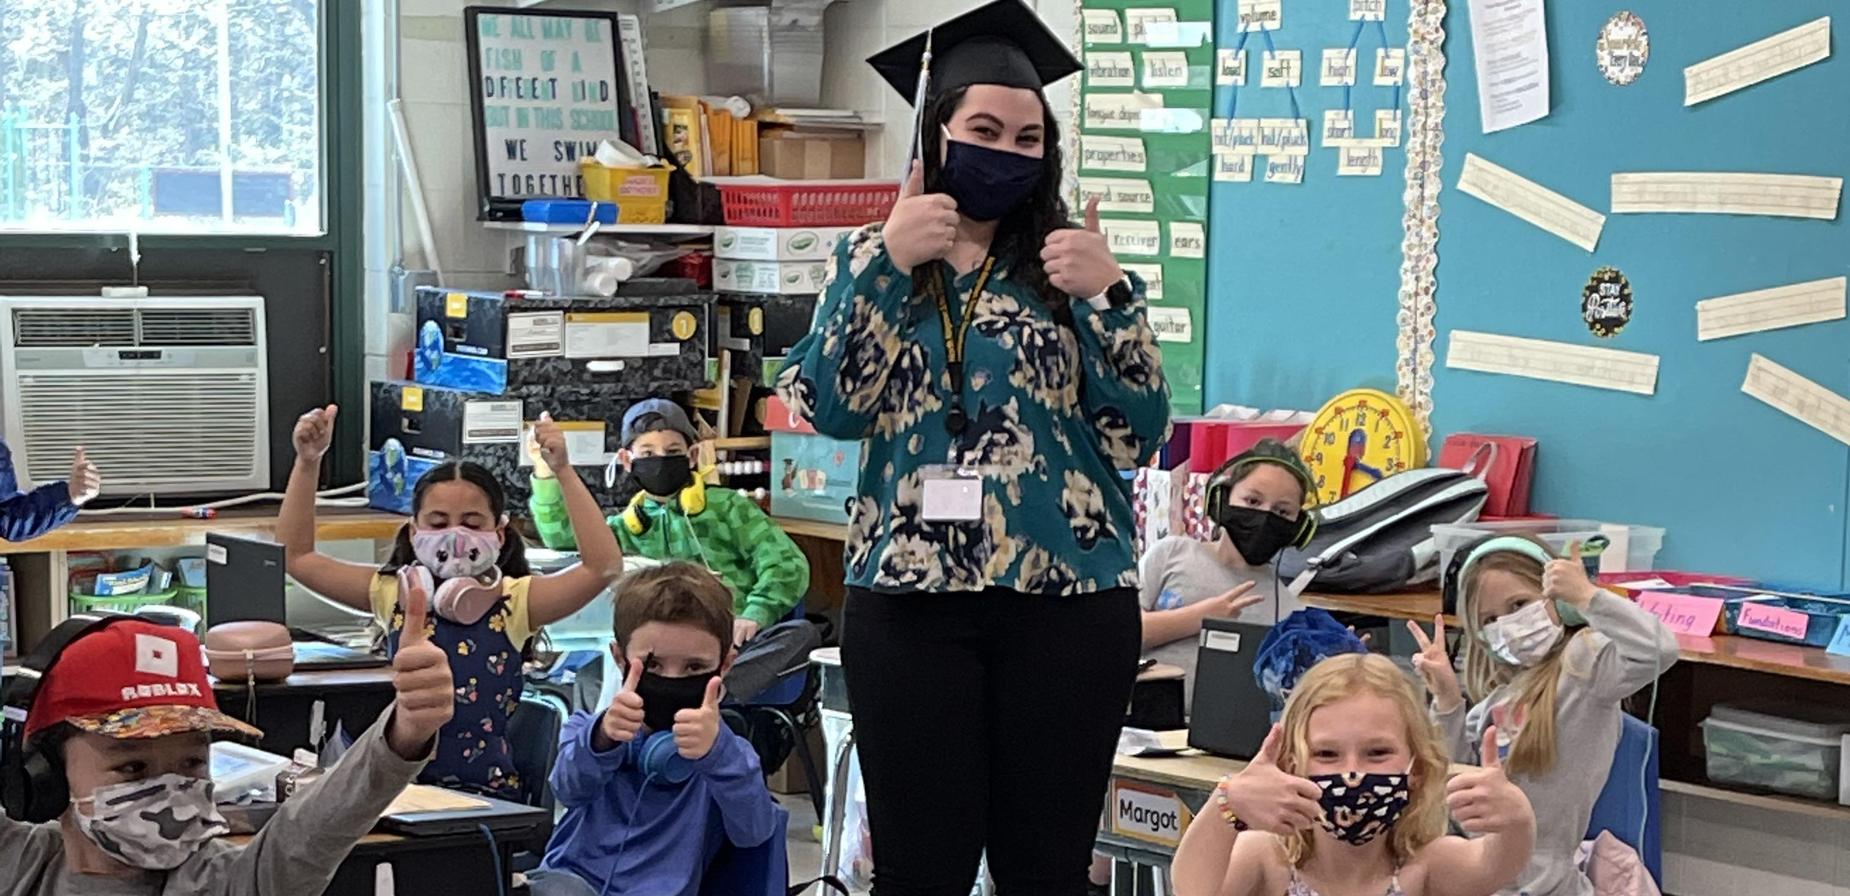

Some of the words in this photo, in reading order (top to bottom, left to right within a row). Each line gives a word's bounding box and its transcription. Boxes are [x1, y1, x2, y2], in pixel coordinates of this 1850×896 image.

[1240, 4, 1277, 23] volume
[1088, 18, 1117, 34] sound
[571, 50, 582, 72] A
[1150, 60, 1183, 77] listen
[1268, 59, 1291, 78] soft
[504, 139, 528, 161] WE
[1085, 144, 1144, 166] properties
[497, 172, 586, 196] TOGETHE
[1174, 237, 1201, 249] ears
[1340, 418, 1349, 432] 11
[1355, 413, 1367, 427] 12
[1324, 432, 1336, 445] 10
[1383, 435, 1392, 449] 2
[1316, 452, 1323, 466] 9
[1386, 457, 1394, 472] 3
[1317, 475, 1326, 489] 8
[121, 682, 202, 701] ROBLOX
[1120, 798, 1178, 832] Margot
